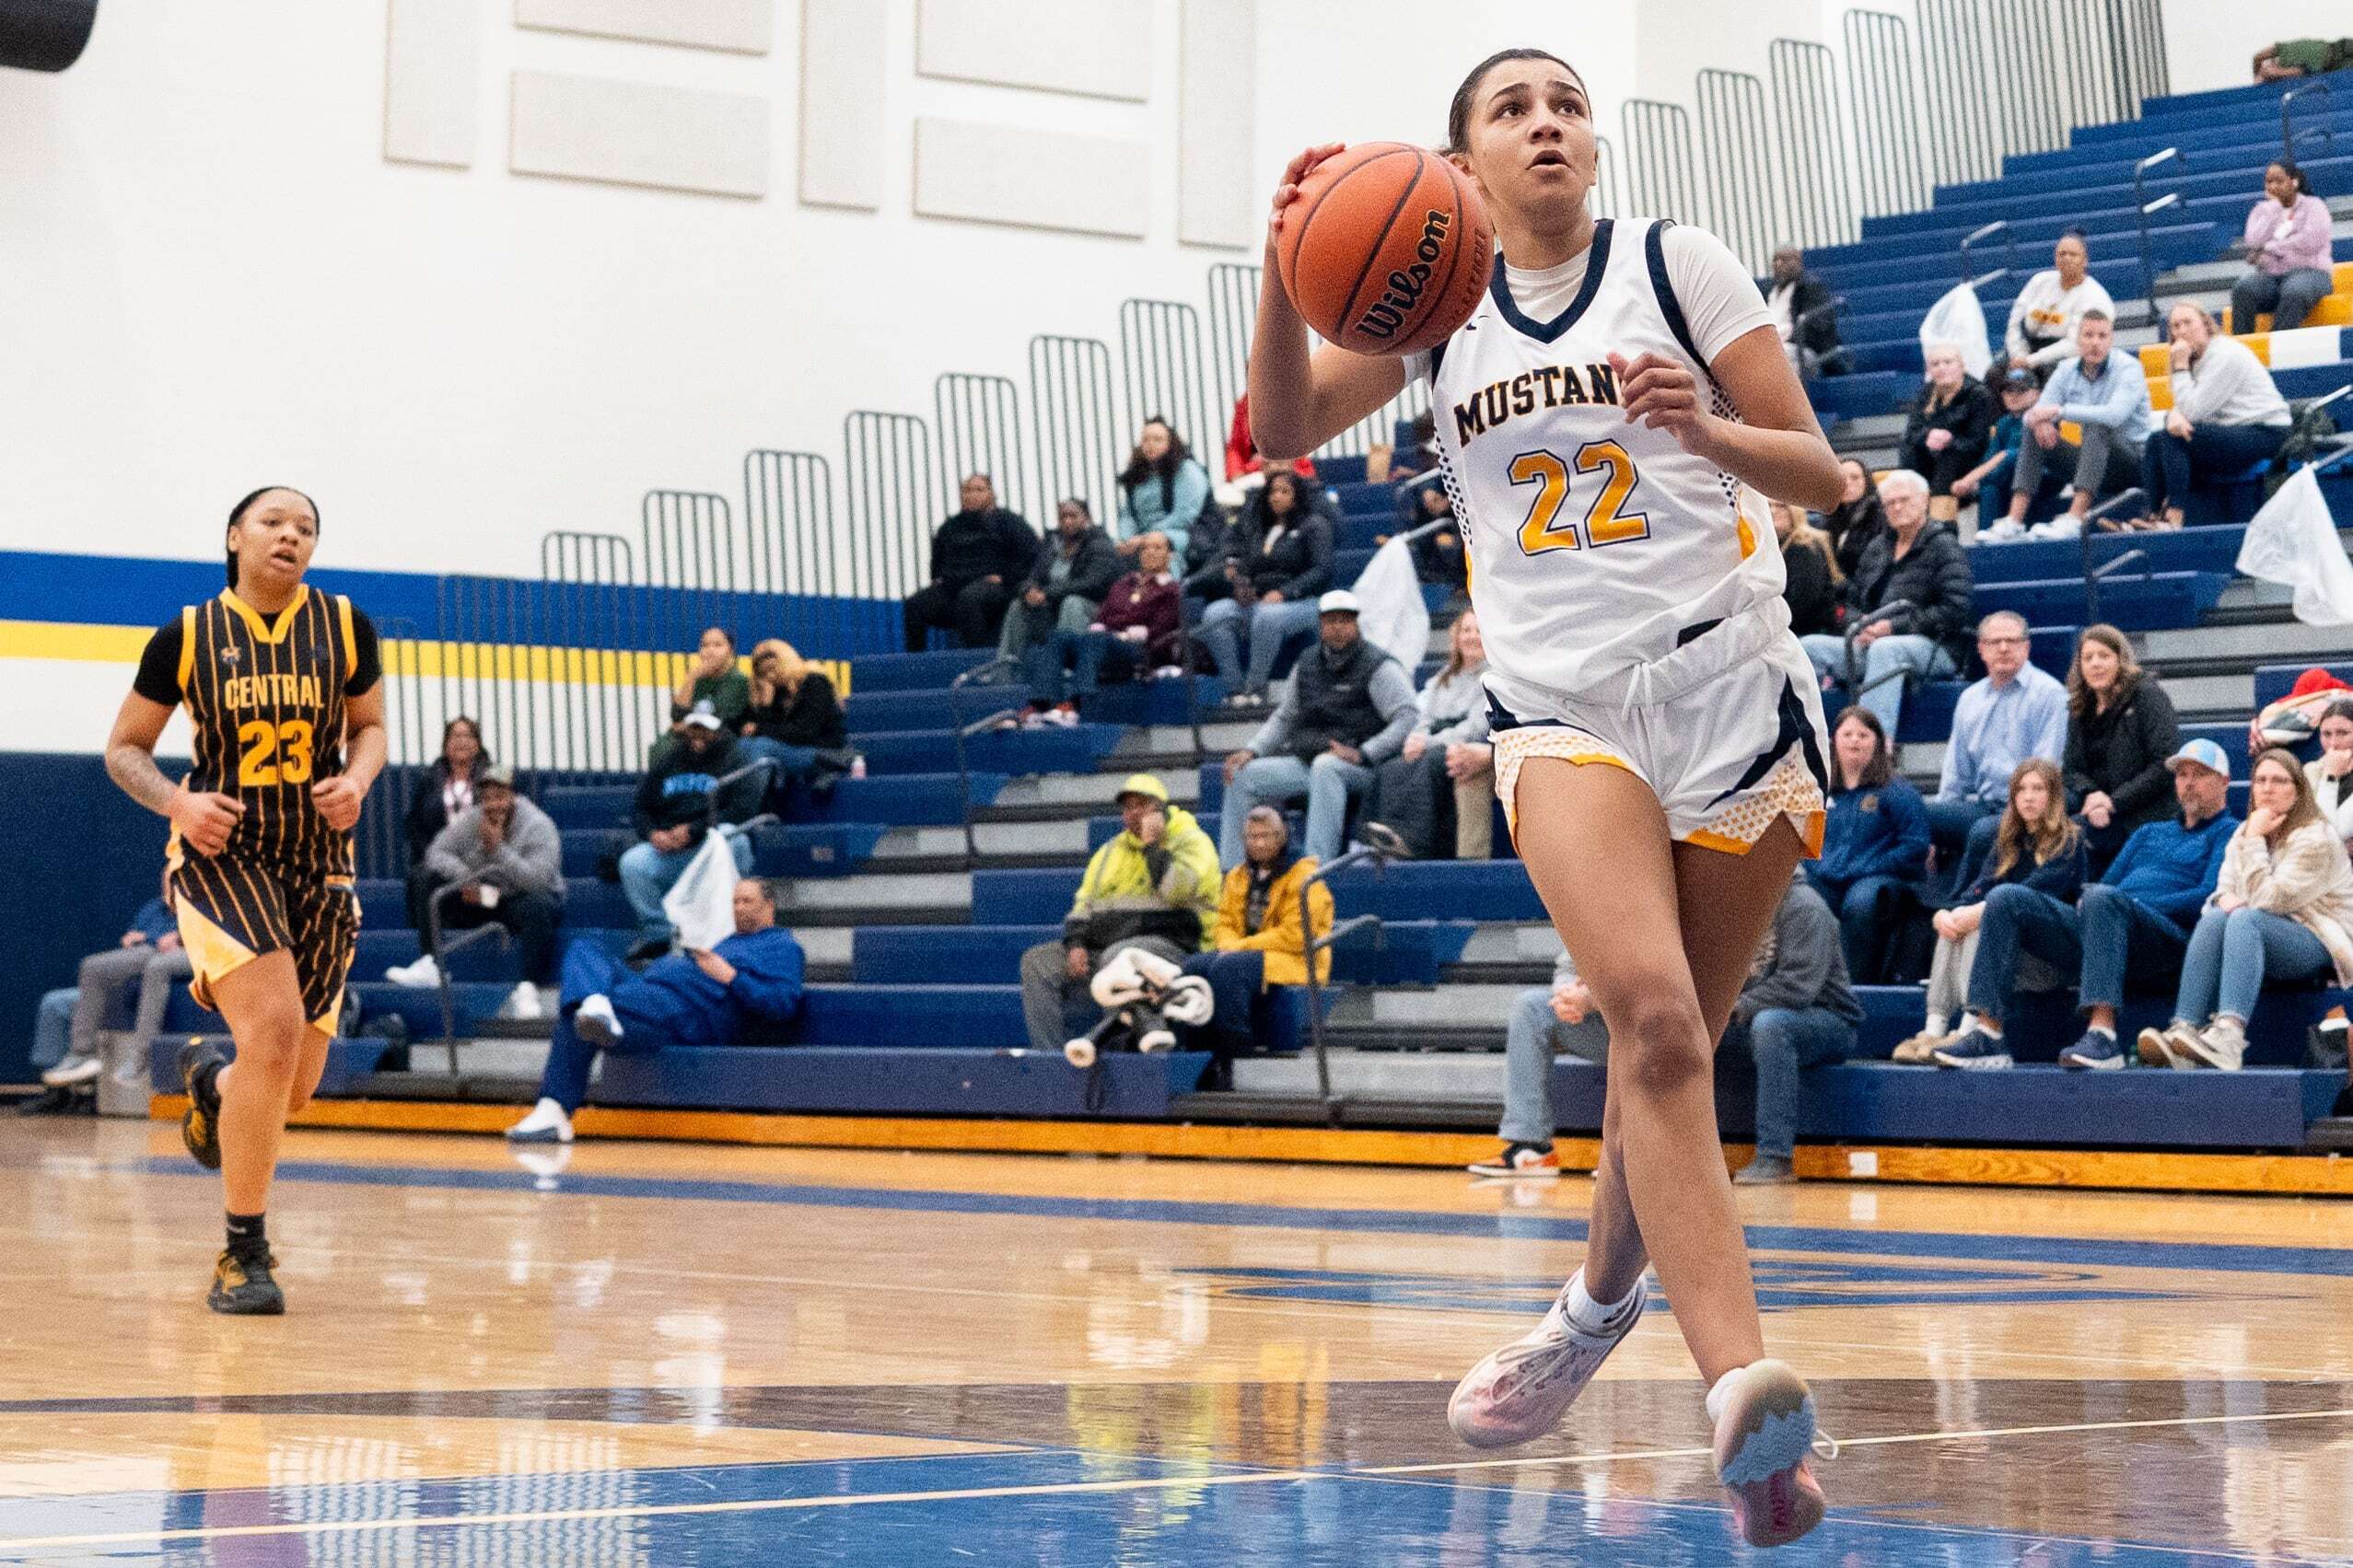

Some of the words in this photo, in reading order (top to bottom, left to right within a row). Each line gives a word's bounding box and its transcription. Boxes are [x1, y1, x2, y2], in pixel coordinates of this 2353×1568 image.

[1355, 209, 1452, 340] Wilson
[1453, 363, 1623, 448] MUSTAN
[1507, 438, 1651, 556] 22
[225, 674, 325, 710] CENTRAL
[238, 720, 314, 786] 23
